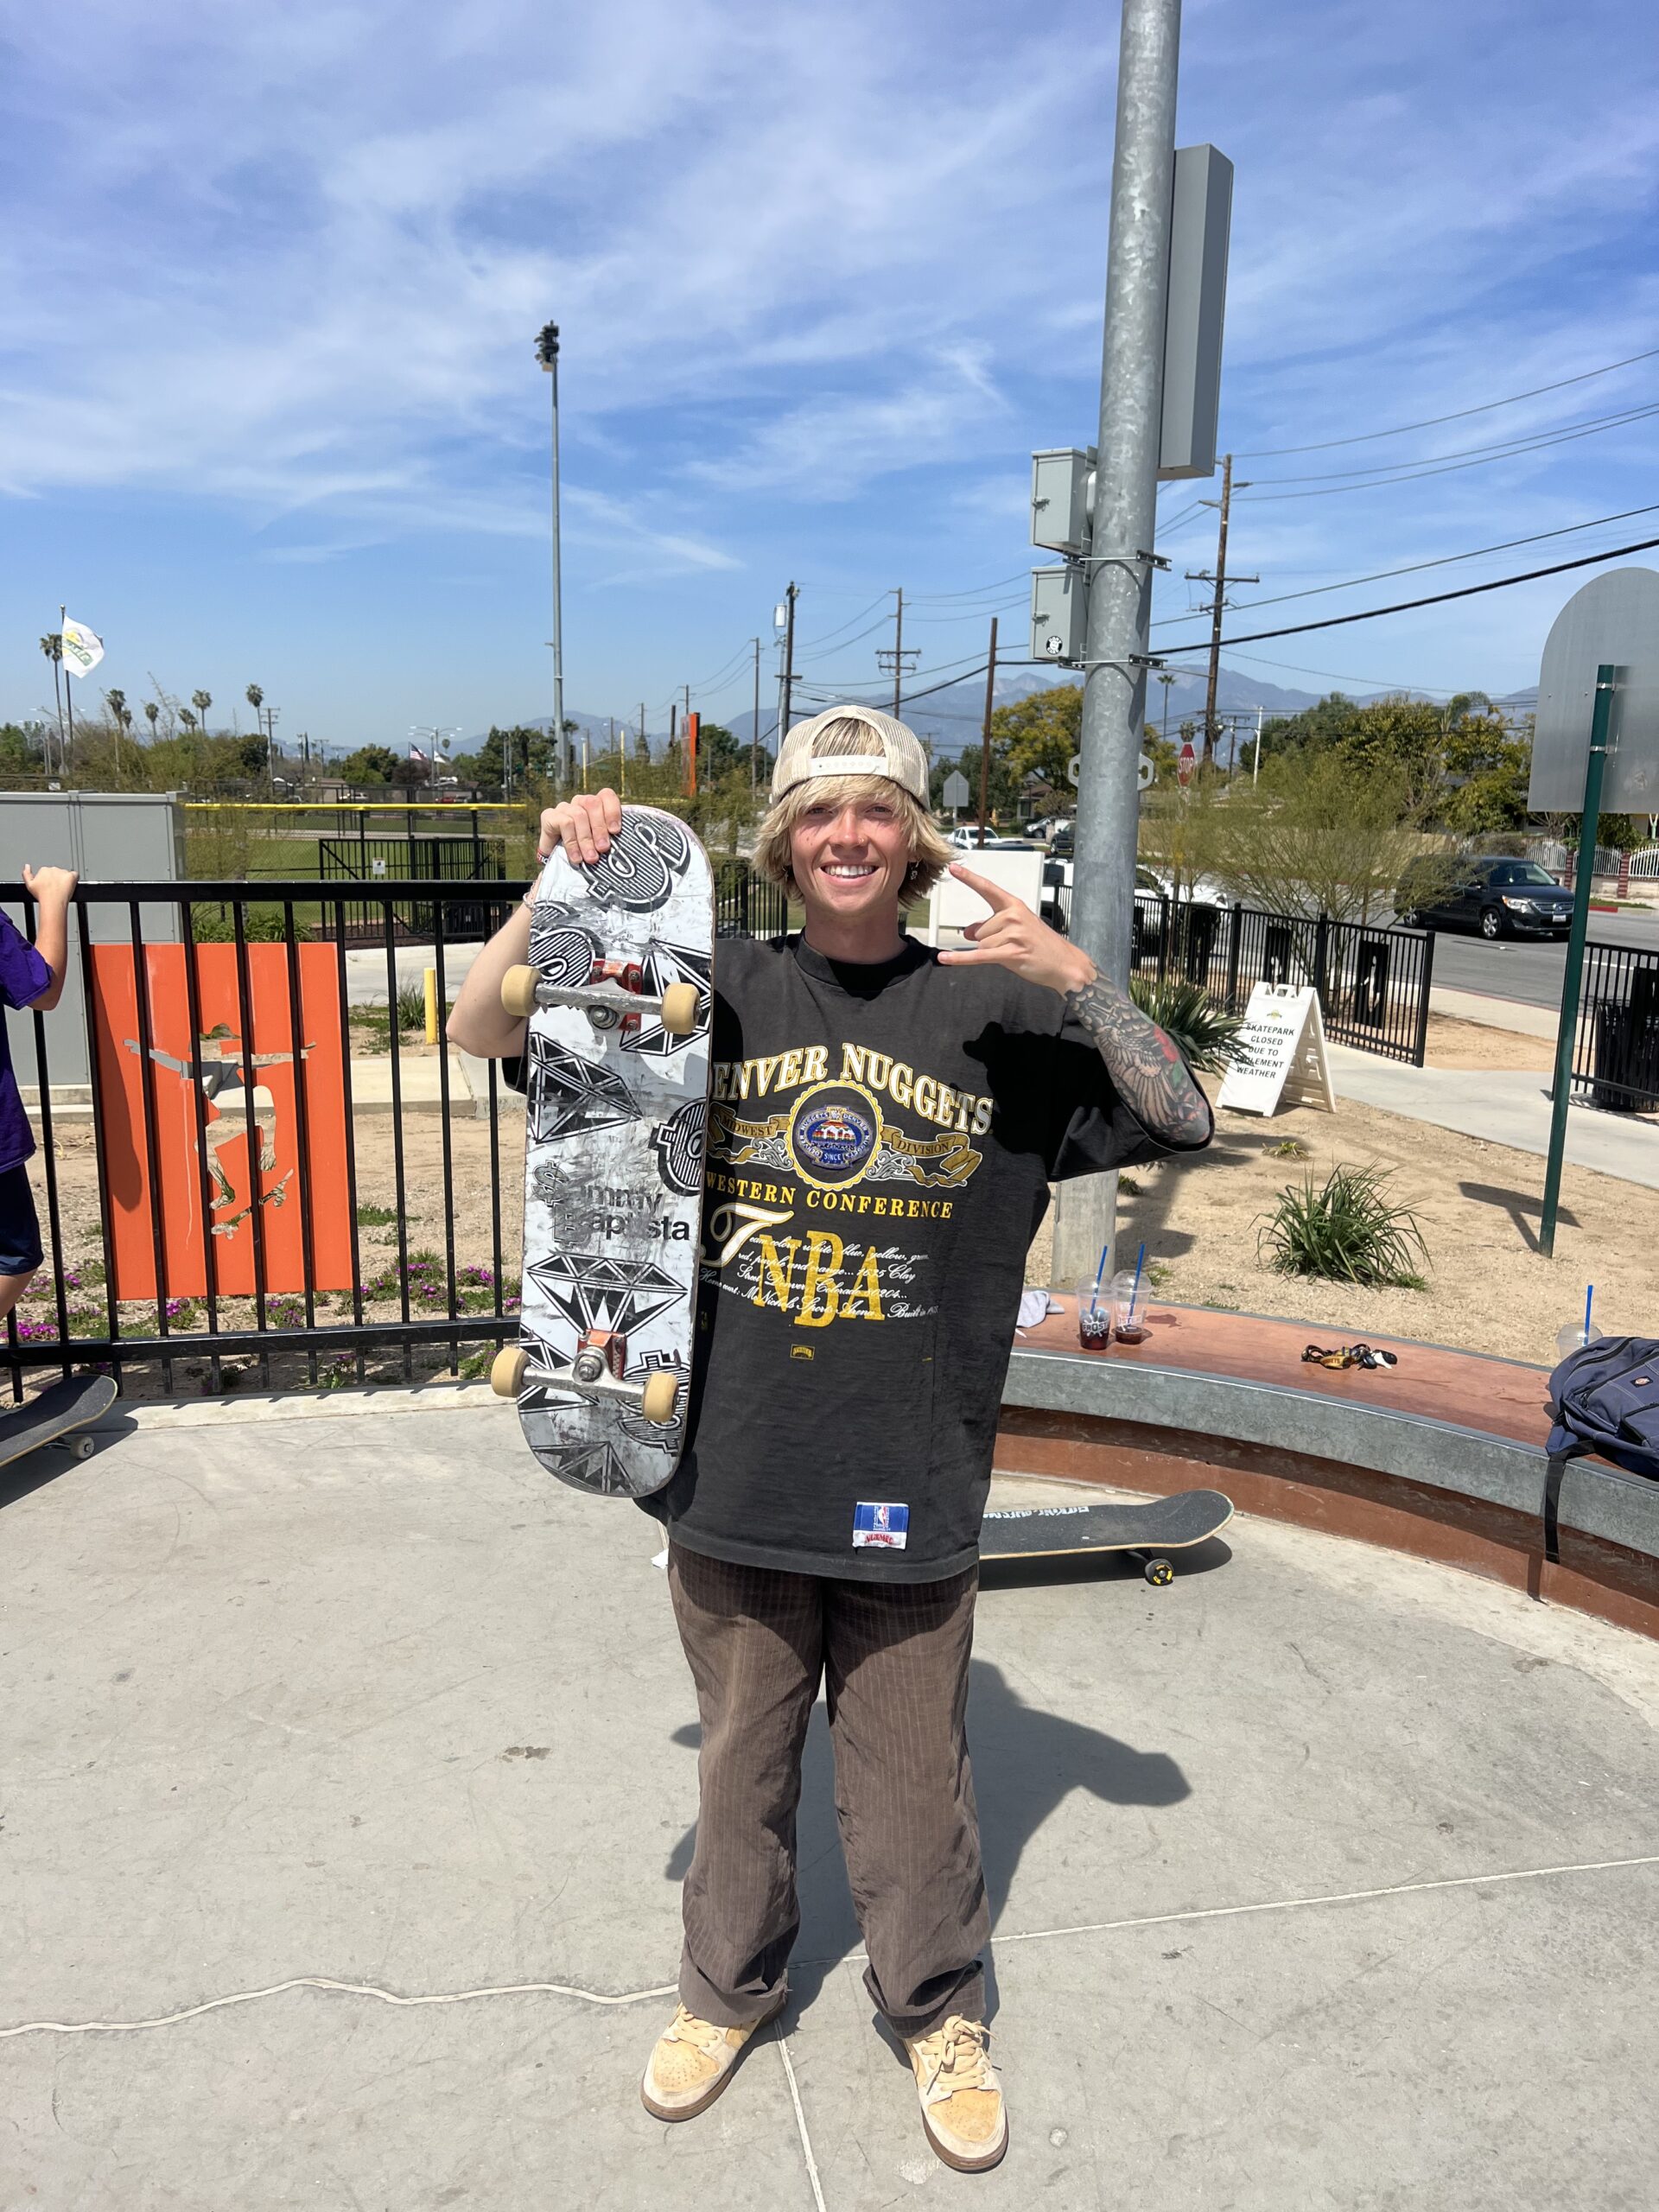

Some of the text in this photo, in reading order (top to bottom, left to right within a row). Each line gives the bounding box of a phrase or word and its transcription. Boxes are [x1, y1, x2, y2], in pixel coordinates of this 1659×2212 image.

[1179, 757, 1194, 774] STOP
[1246, 1022, 1295, 1036] SKATEPARK
[1250, 1035, 1283, 1046] CLOSED
[1249, 1046, 1279, 1057] DUE TO
[1236, 1065, 1276, 1079] WEATHER
[712, 1042, 994, 1135] ENVER NUGGETS
[896, 1140, 950, 1154] DIVISION
[705, 1171, 953, 1219] WESTERN CONFERENCE
[753, 1230, 886, 1327] NBA
[887, 1263, 916, 1284] Clay
